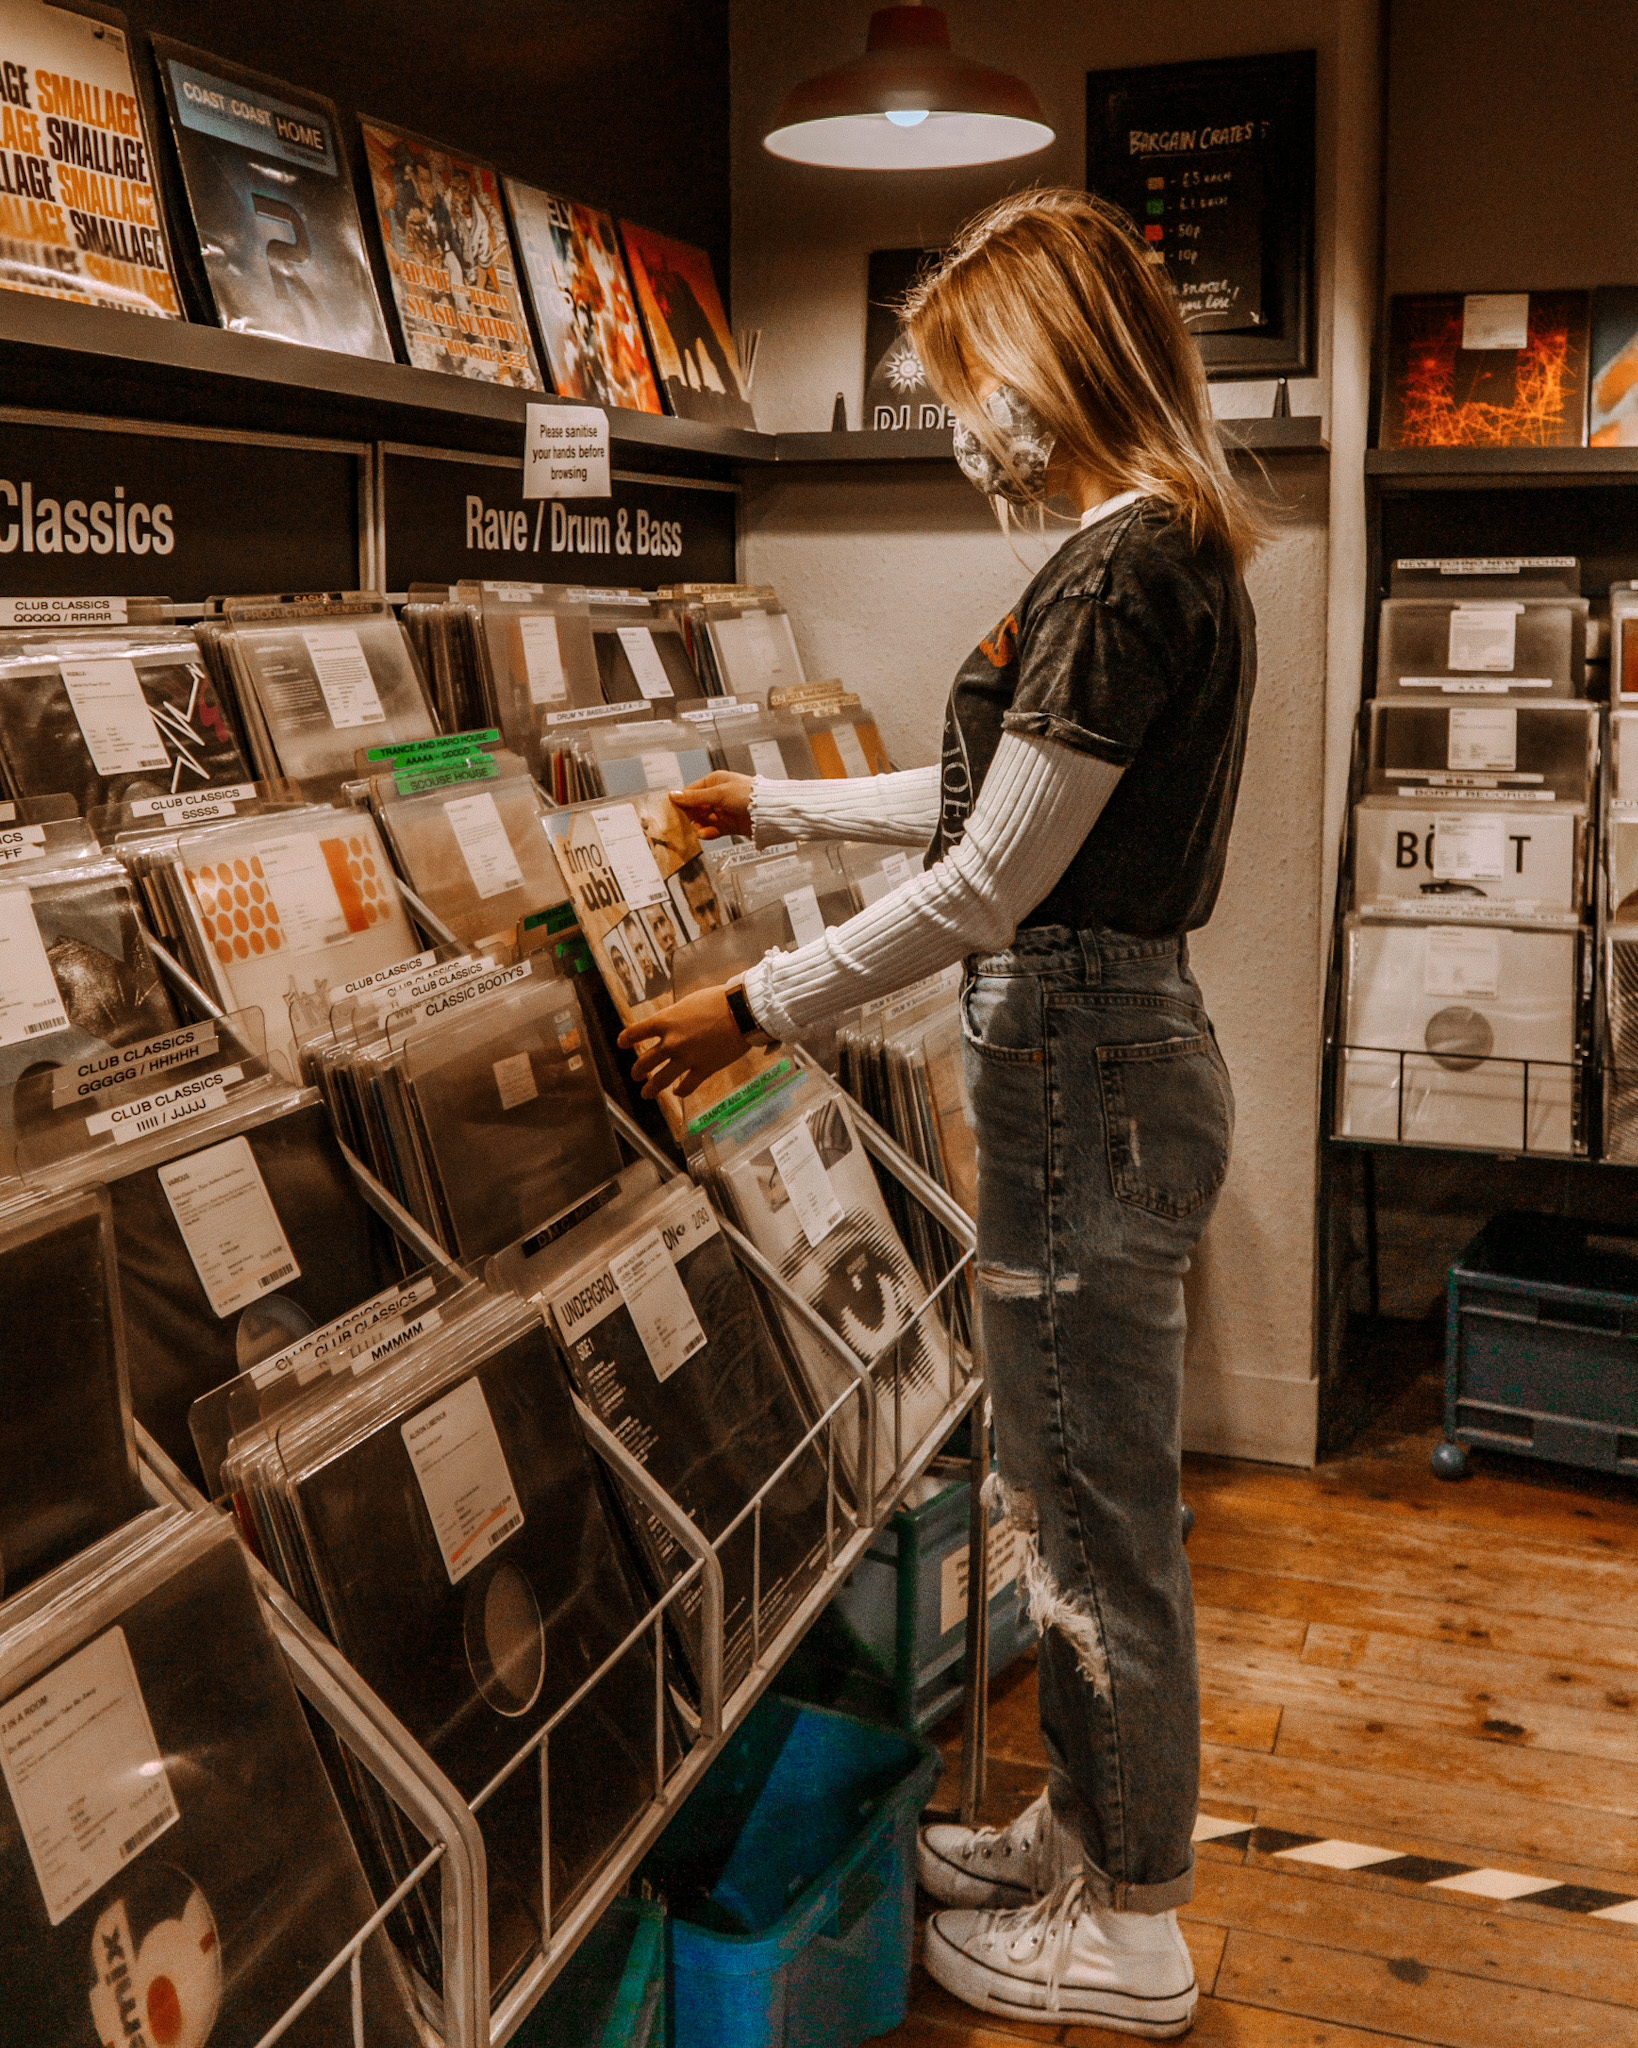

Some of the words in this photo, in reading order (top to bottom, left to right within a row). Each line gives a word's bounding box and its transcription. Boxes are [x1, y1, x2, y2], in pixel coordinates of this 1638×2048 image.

[0, 60, 33, 110] GE
[34, 69, 141, 138] SMALLAGE
[182, 81, 226, 112] COAST
[230, 99, 272, 127] COAST
[276, 119, 324, 150] HOME
[0, 105, 44, 157] AGE
[48, 116, 148, 183] SMALLAGE
[1128, 130, 1198, 156] BARGAIN
[1199, 121, 1255, 150] CRATES
[0, 153, 57, 203] LAGE
[56, 163, 158, 228] SMALLAGE
[69, 208, 164, 270] SMALLAGE
[539, 424, 564, 439] Please
[565, 425, 598, 439] sanitise
[873, 404, 911, 431] DJ
[532, 446, 551, 463] your
[552, 446, 577, 460] hands
[578, 444, 605, 460] before
[550, 465, 588, 482] browsing
[0, 479, 176, 556] Classics
[465, 494, 529, 551] Rave
[532, 500, 546, 553] /
[550, 502, 612, 554] Drum
[614, 507, 633, 556] &
[636, 509, 682, 558] Bass
[13, 612, 62, 623] QQQQQ
[70, 612, 112, 622] RRRRR
[14, 601, 49, 611] CLUB
[51, 600, 110, 611] CLASSICS
[381, 744, 416, 757] TRANCE
[417, 741, 435, 751] AND
[436, 737, 460, 748] HARD
[460, 732, 488, 744] HOUSE
[410, 774, 452, 791] SCOUSE
[454, 768, 489, 781] HOUSE
[150, 799, 184, 811] CLUB
[185, 789, 241, 806] CLASSICS
[181, 806, 220, 820] SSSSS
[563, 840, 603, 875] timo
[345, 976, 374, 994] CLUB
[375, 958, 423, 983] CLASSICS
[411, 980, 438, 998] CLUB
[439, 963, 484, 987] CLASSICS
[425, 984, 477, 1018] CLASSIC
[477, 965, 525, 995] BOOTY'S
[77, 1053, 121, 1078] CLUB
[123, 1031, 196, 1064] CLASSICS
[77, 1066, 138, 1097] GGGGG
[149, 1046, 200, 1072] HHHHH
[111, 1098, 152, 1123] CLUB
[154, 1073, 224, 1108] CLASSICS
[171, 1098, 207, 1121] JJJJJ
[697, 1102, 727, 1125] TRANCE
[727, 1091, 742, 1107] AND
[315, 1332, 352, 1358] CLUB
[354, 1291, 418, 1336] CLASSICS
[371, 1321, 424, 1361] MMMMM
[24, 1695, 48, 1717] ROOM
